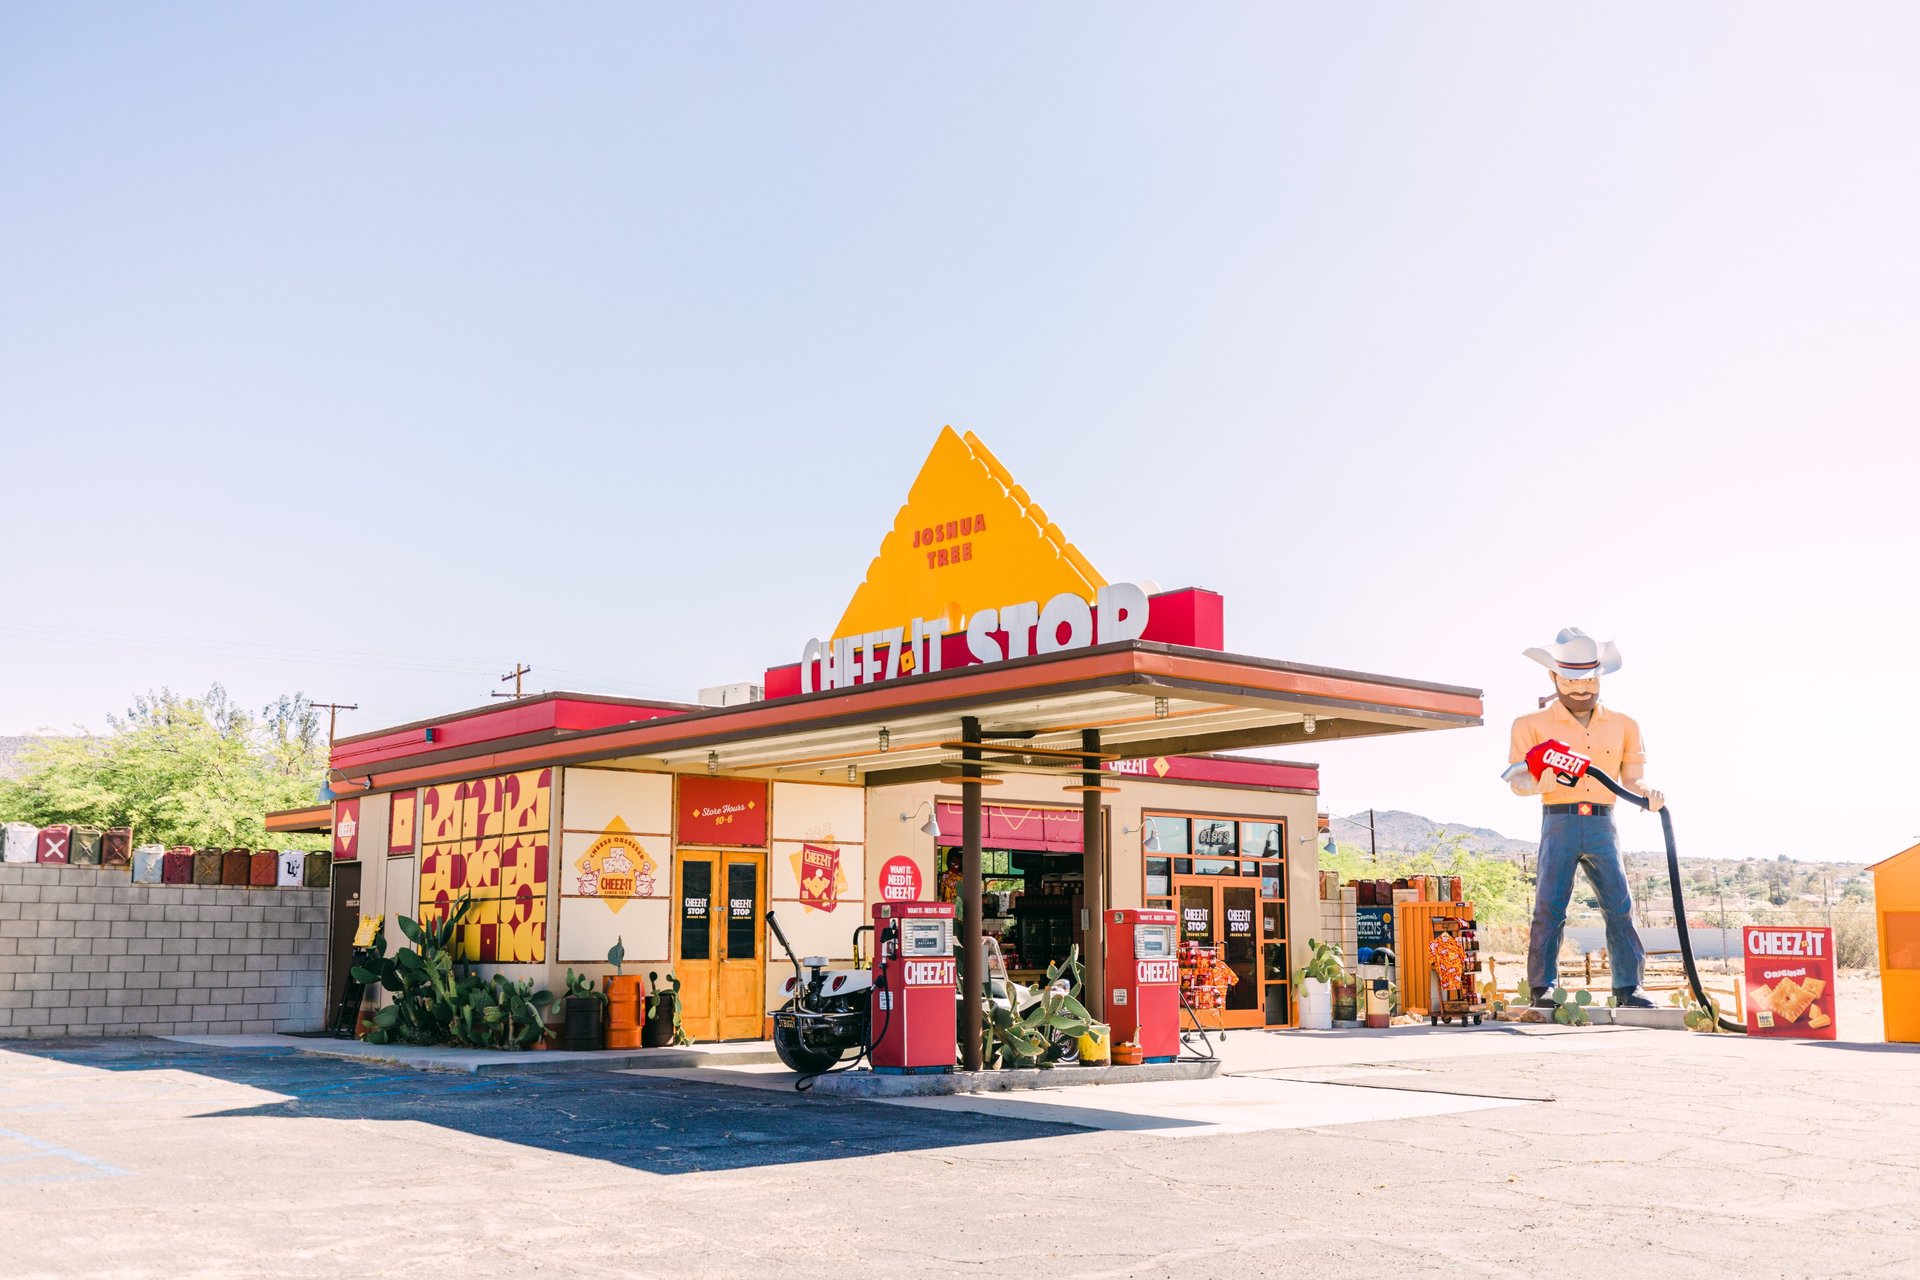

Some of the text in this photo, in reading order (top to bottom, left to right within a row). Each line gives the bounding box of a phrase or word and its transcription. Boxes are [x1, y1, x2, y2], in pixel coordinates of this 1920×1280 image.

[913, 513, 986, 549] JOSHUA
[926, 542, 973, 570] TREE
[801, 582, 1150, 695] CHEEZ-IT STOP
[1542, 748, 1586, 774] CHEEZ-IT
[701, 804, 746, 817] Store Hours
[715, 815, 733, 826] 10-6
[589, 837, 644, 860] CHEESE OBSESSED
[804, 848, 833, 868] CHEEZ-IT
[889, 865, 905, 874] WANT
[601, 877, 633, 891] CHEEZ-IT
[888, 874, 915, 886] NEED IT.
[884, 885, 916, 900] CHEEZ-IT
[685, 897, 707, 907] CHEEZ-IT
[730, 898, 752, 908] CHEEZ-IT
[733, 908, 750, 916] STOP
[1184, 908, 1208, 921] CHEEZ-IT
[1227, 909, 1251, 922] CHEEZ-IT
[1187, 921, 1206, 931] STOP
[1230, 922, 1249, 932] STOP
[1357, 921, 1381, 935] OKENS
[1748, 930, 1825, 956] CHEEZ-IT
[904, 960, 956, 985] CHEEZ-IT
[1137, 961, 1178, 983] CHEEZ-IT
